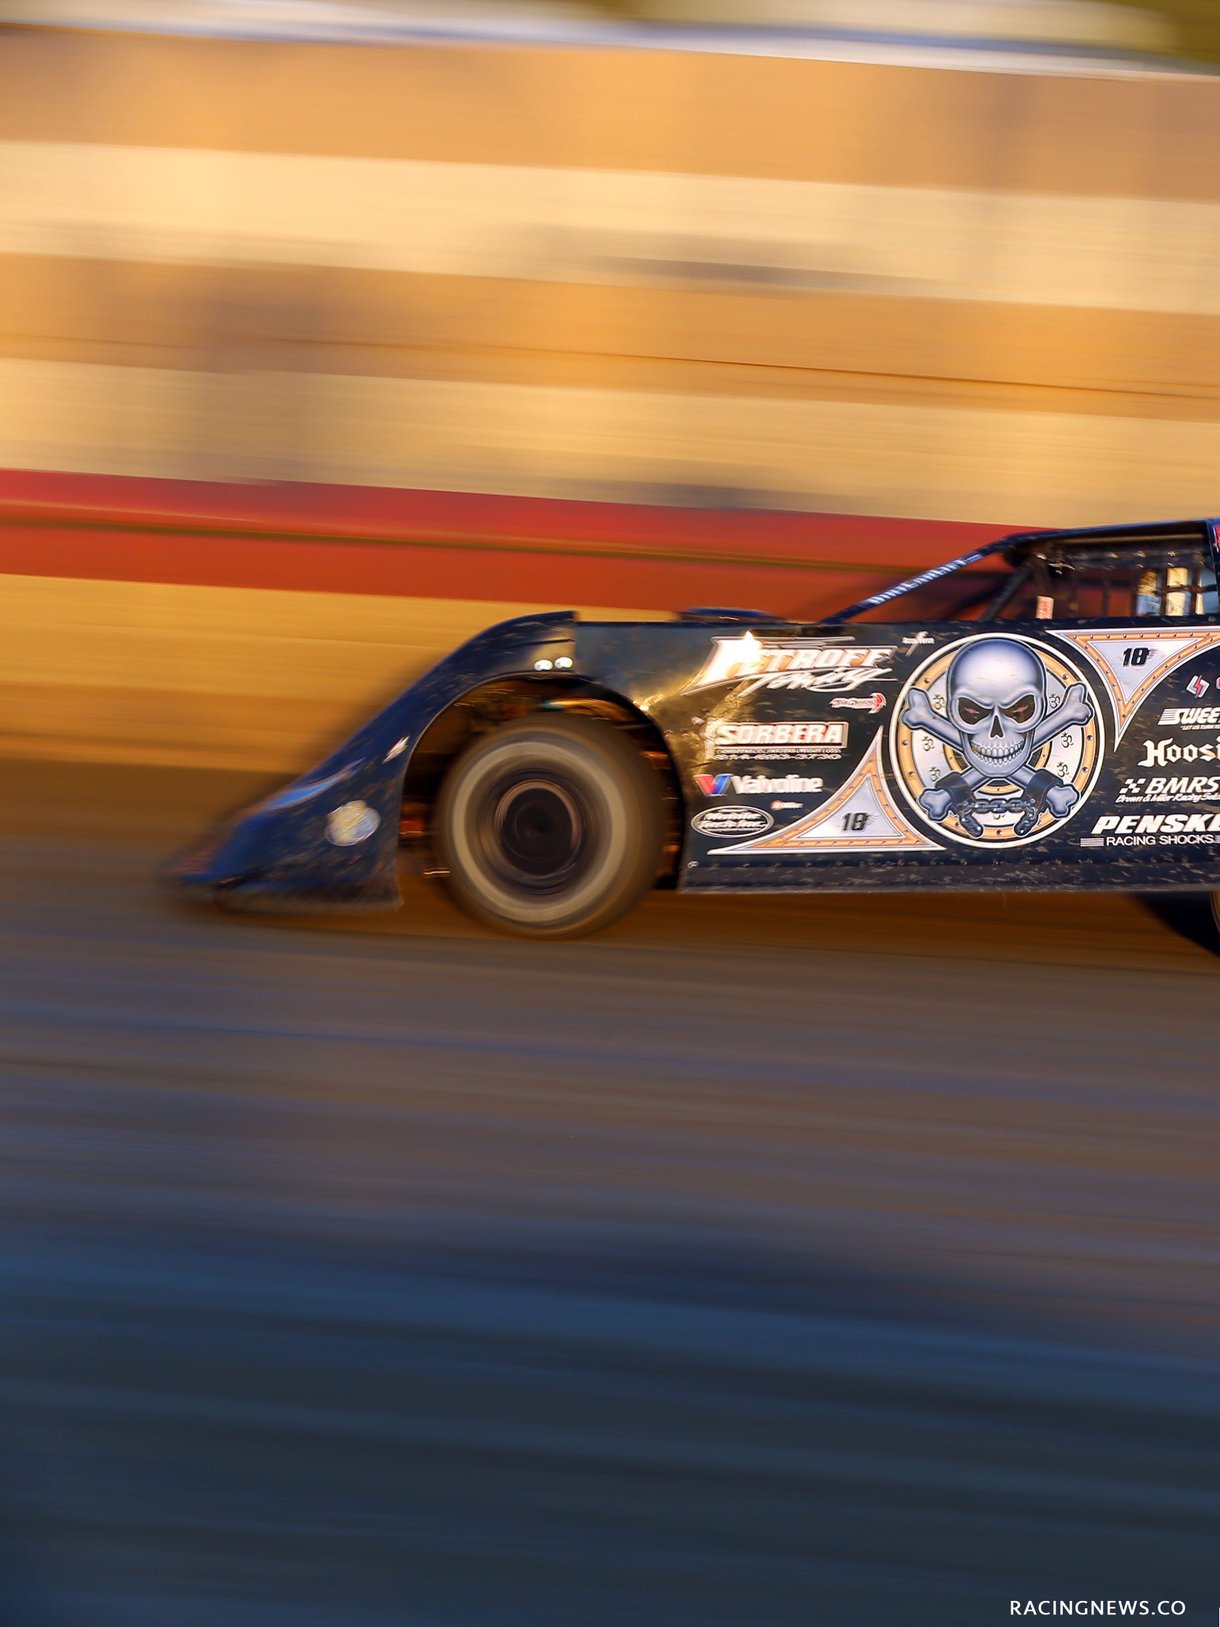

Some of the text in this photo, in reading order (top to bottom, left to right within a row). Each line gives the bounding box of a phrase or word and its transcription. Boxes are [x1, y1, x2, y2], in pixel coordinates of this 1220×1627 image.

[1122, 648, 1150, 667] 18
[715, 724, 843, 745] SORBERA
[731, 773, 824, 794] Valvoline
[1173, 793, 1201, 803] Racing
[841, 812, 869, 831] 18
[1106, 834, 1215, 847] RACING SHOCKS
